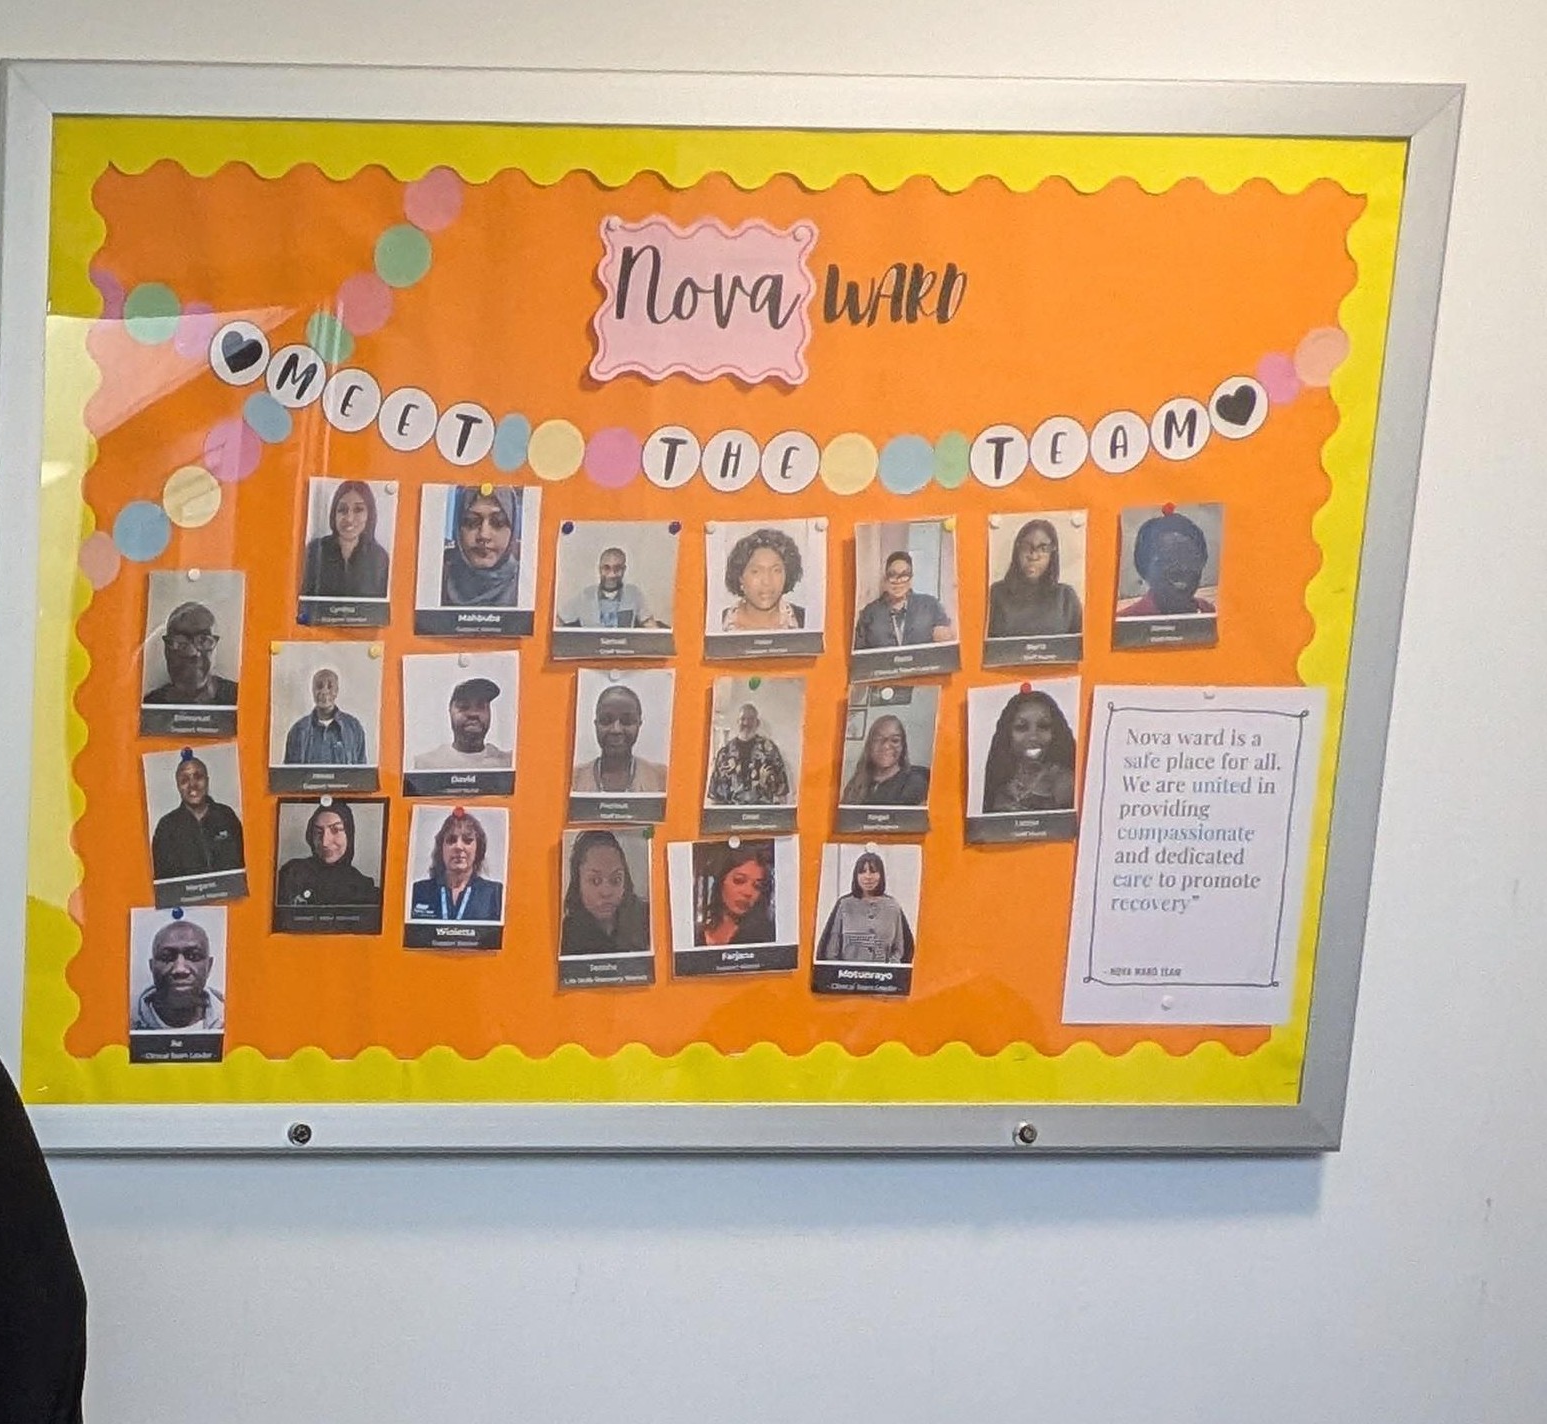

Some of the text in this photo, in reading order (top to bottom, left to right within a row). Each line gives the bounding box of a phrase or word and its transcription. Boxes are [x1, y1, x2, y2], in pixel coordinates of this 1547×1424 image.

[615, 244, 967, 330] Nova WARD
[274, 351, 1199, 482] MEET THE TEAM
[1125, 728, 1262, 747] Nova ward is a
[1123, 752, 1282, 773] safe place for all.
[1122, 775, 1276, 795] We are united in
[1118, 799, 1211, 821] providing
[1116, 823, 1256, 844] compassionate
[1113, 846, 1245, 866] and dedicated
[1112, 872, 1262, 892] care to promote
